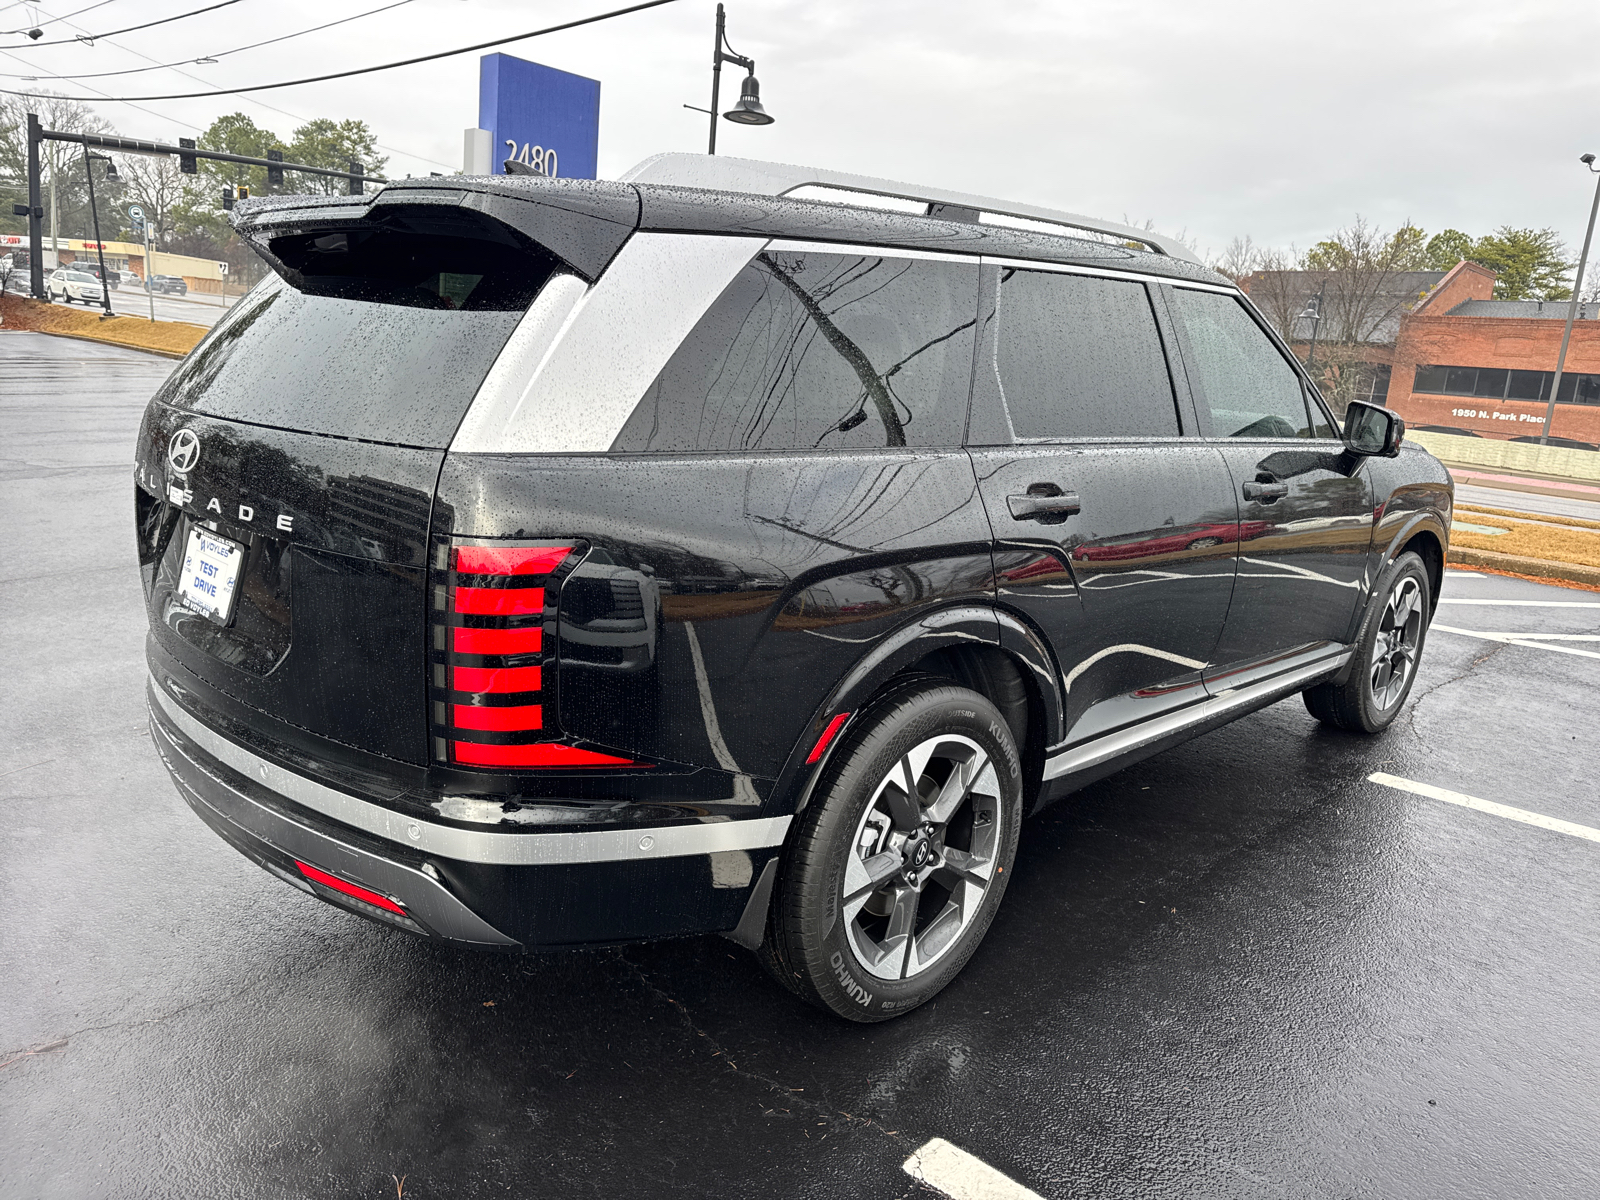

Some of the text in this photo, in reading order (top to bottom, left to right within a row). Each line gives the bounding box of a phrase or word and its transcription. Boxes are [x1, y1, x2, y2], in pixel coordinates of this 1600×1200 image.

[504, 139, 558, 178] 2480
[1451, 408, 1477, 418] 1950
[1478, 410, 1490, 419] N.
[1492, 412, 1517, 422] Park
[134, 460, 294, 532] ALISADE
[206, 540, 229, 558] VOYLES
[199, 560, 219, 579] TEST
[193, 576, 217, 598] DRIVE
[190, 600, 210, 619] VOYLES
[948, 709, 977, 719] OUTSIDE
[988, 720, 1018, 779] KUMHO
[830, 951, 873, 1007] KUMHO
